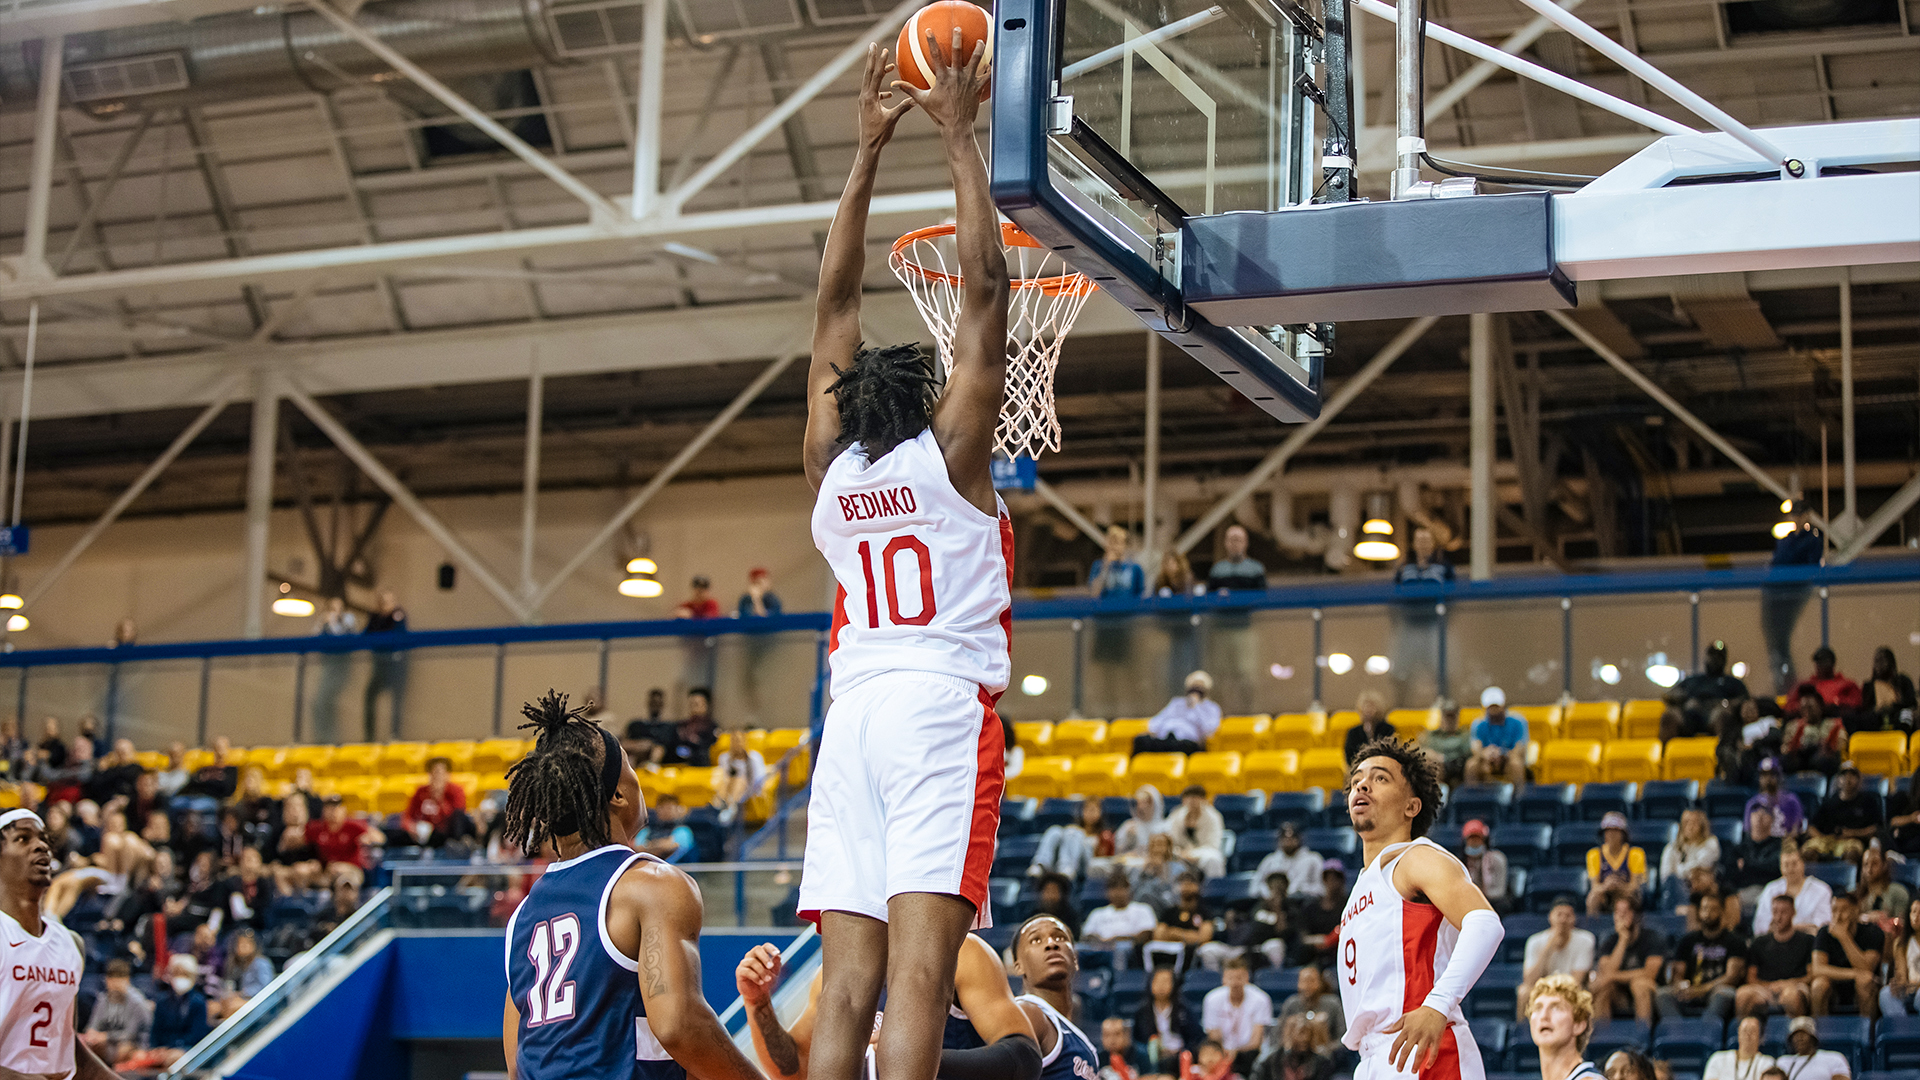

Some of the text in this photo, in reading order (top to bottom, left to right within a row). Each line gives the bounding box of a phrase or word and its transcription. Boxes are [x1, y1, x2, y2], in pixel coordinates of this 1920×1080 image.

[837, 486, 917, 522] BEDIAKO
[858, 535, 937, 629] 10
[1341, 891, 1374, 931] ANADA
[13, 964, 76, 986] CANADA
[527, 912, 581, 1029] 12
[1345, 937, 1357, 986] 9
[30, 1001, 52, 1048] 2
